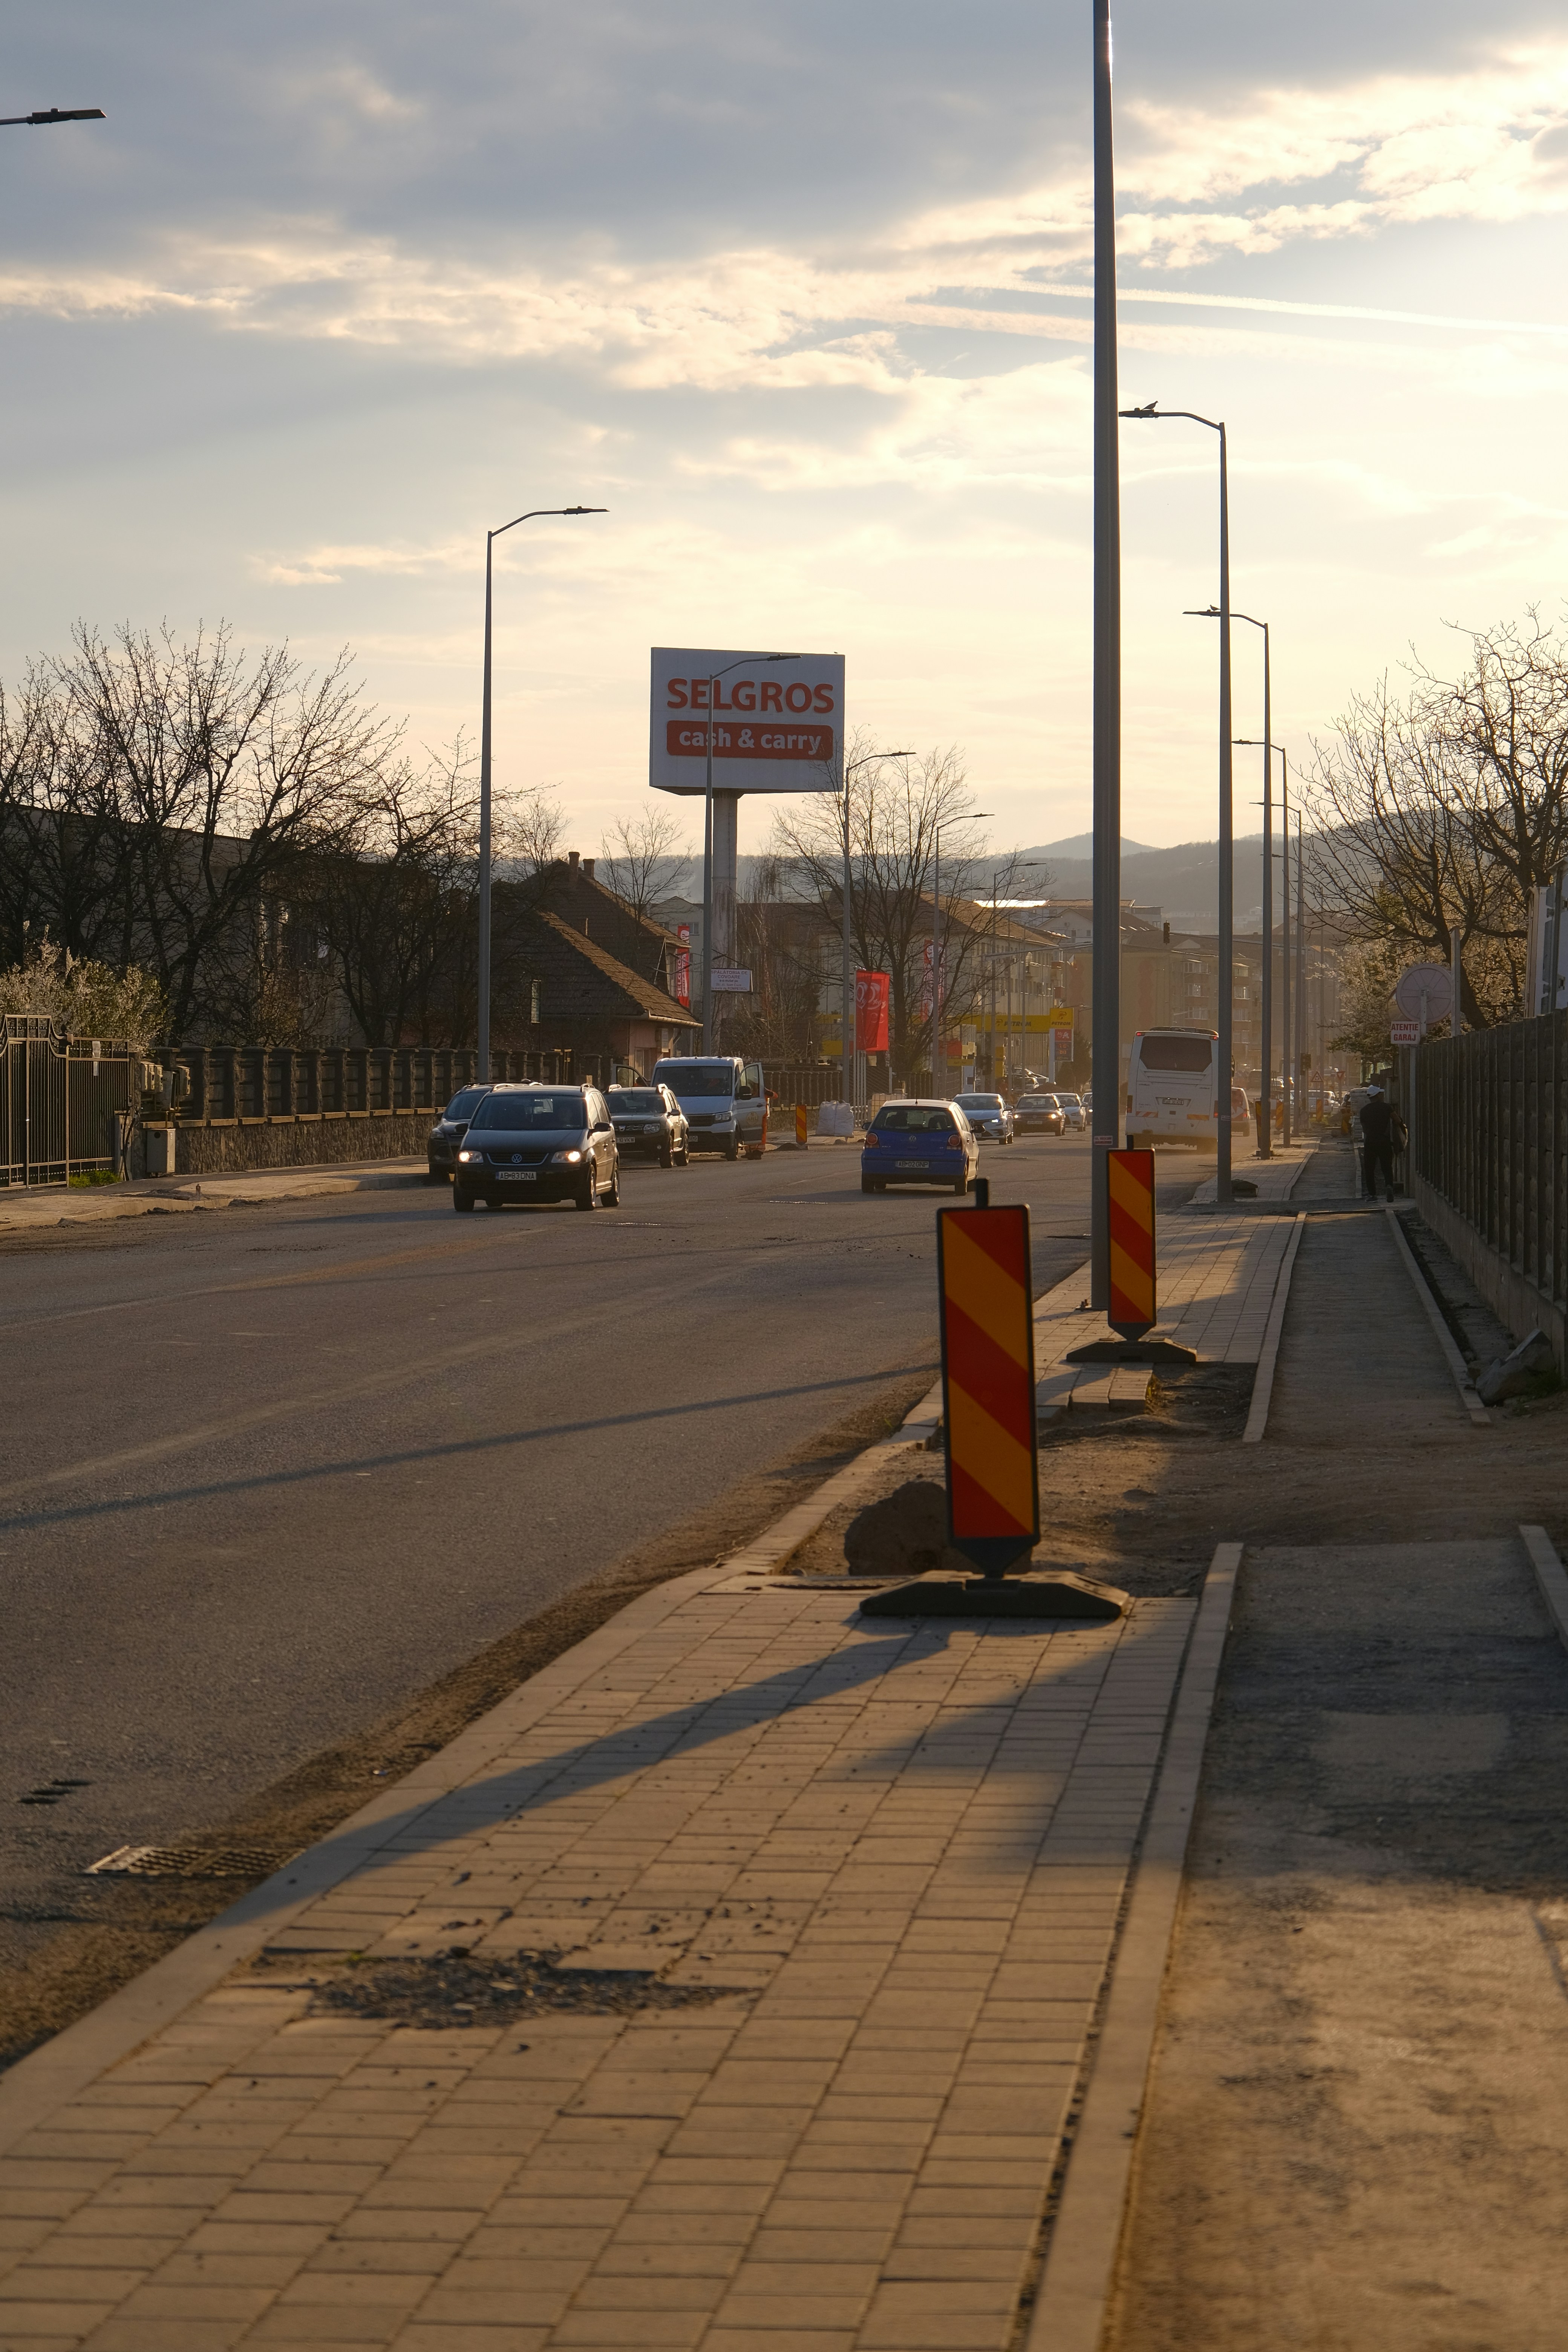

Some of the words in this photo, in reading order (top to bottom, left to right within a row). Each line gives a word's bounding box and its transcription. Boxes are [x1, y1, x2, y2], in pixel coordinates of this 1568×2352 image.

[667, 678, 834, 713] SELGROS
[679, 728, 730, 748] cash
[738, 729, 754, 748] &
[761, 735, 822, 755] carry
[1391, 1023, 1419, 1032] ATENȚIE
